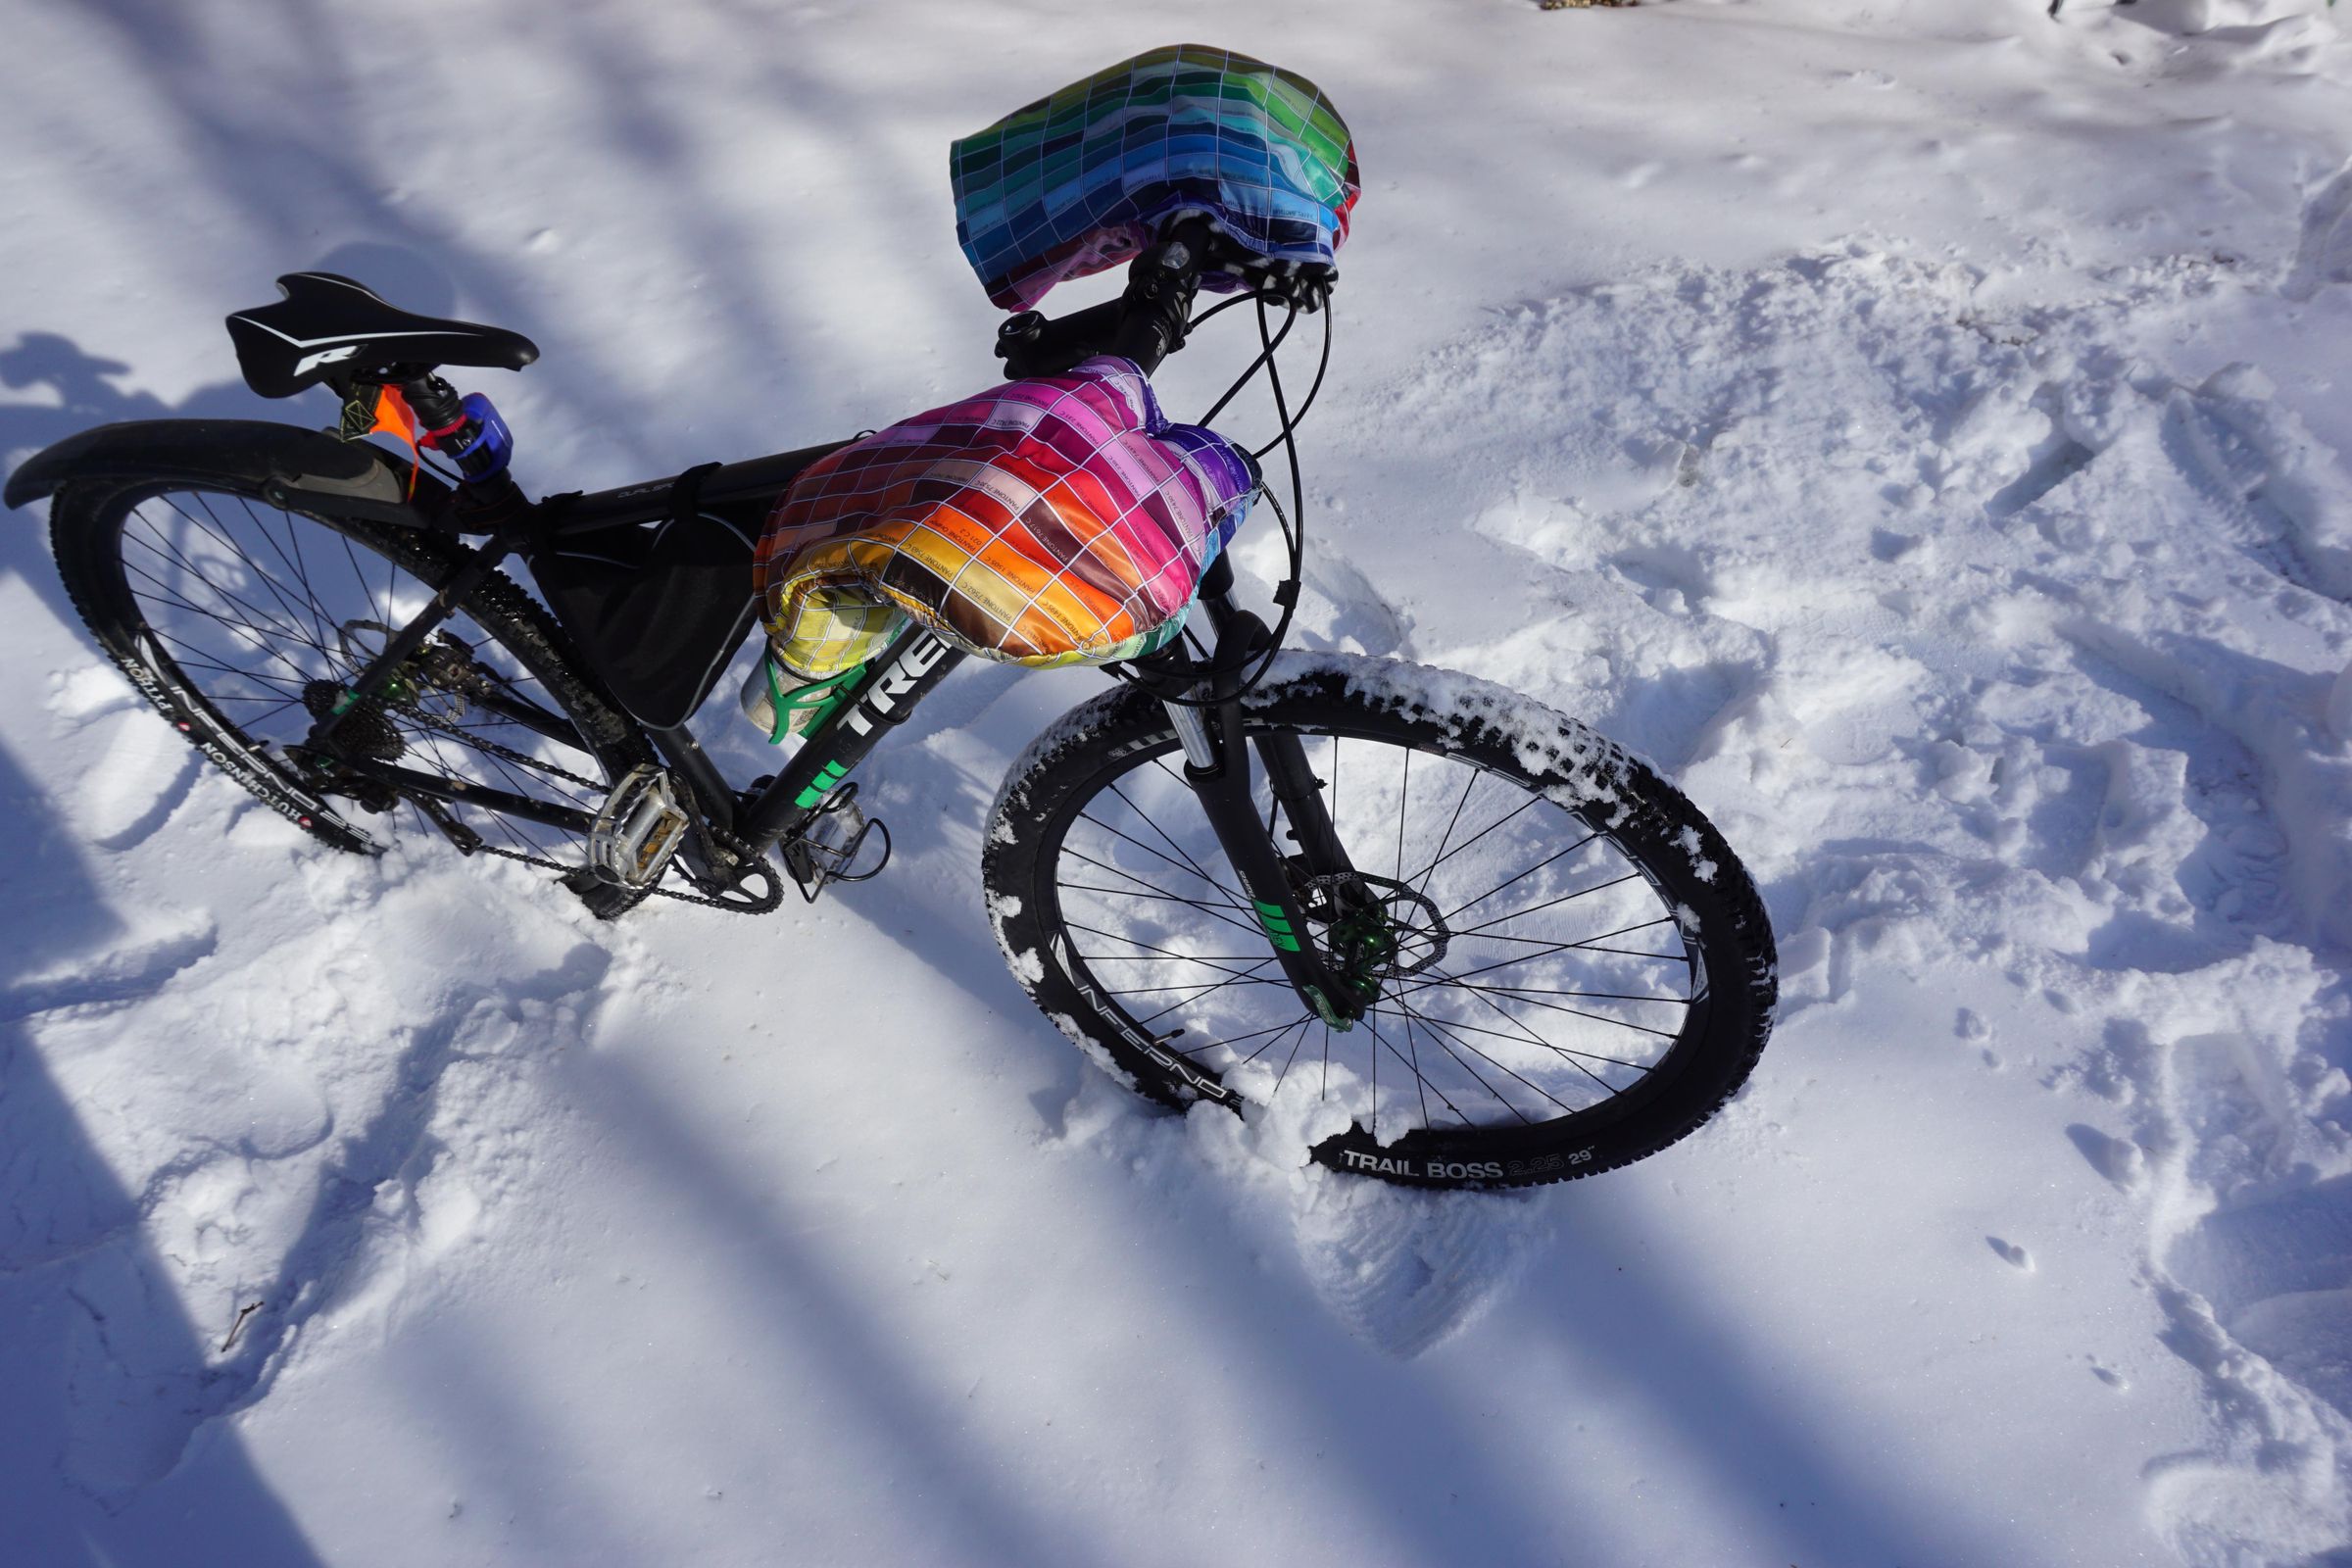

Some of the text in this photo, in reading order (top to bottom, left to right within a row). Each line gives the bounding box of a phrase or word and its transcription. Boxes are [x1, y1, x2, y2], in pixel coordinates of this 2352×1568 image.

[1065, 414, 1077, 423] 231
[1076, 422, 1100, 445] PANTONE
[1112, 460, 1121, 470] 230
[1139, 457, 1159, 482] PANTONE
[1121, 470, 1141, 497] PANTONE
[994, 489, 1019, 511] PANTONE
[1168, 495, 1179, 511] 7430
[1031, 523, 1043, 538] 7617
[1176, 510, 1194, 538] PANTONE
[949, 531, 975, 552] PANTONE
[970, 536, 983, 546] 021
[1042, 537, 1068, 563] PANTONE
[911, 546, 925, 559] 7563
[924, 556, 953, 578] PANTONE
[991, 560, 1006, 572] 1505
[1006, 570, 1035, 594] PANTONE
[967, 586, 984, 601] 7562
[983, 598, 1012, 621] PANTONE
[1048, 605, 1060, 619] 1495
[122, 658, 173, 712] PYTHON
[836, 629, 953, 737] TRE
[202, 741, 301, 823] HUTCHINSON
[1079, 985, 1228, 1099] INFERNO
[1344, 1150, 1419, 1177] TRAIL
[1427, 1161, 1503, 1179] BOSS
[1507, 1153, 1565, 1176] 2.25
